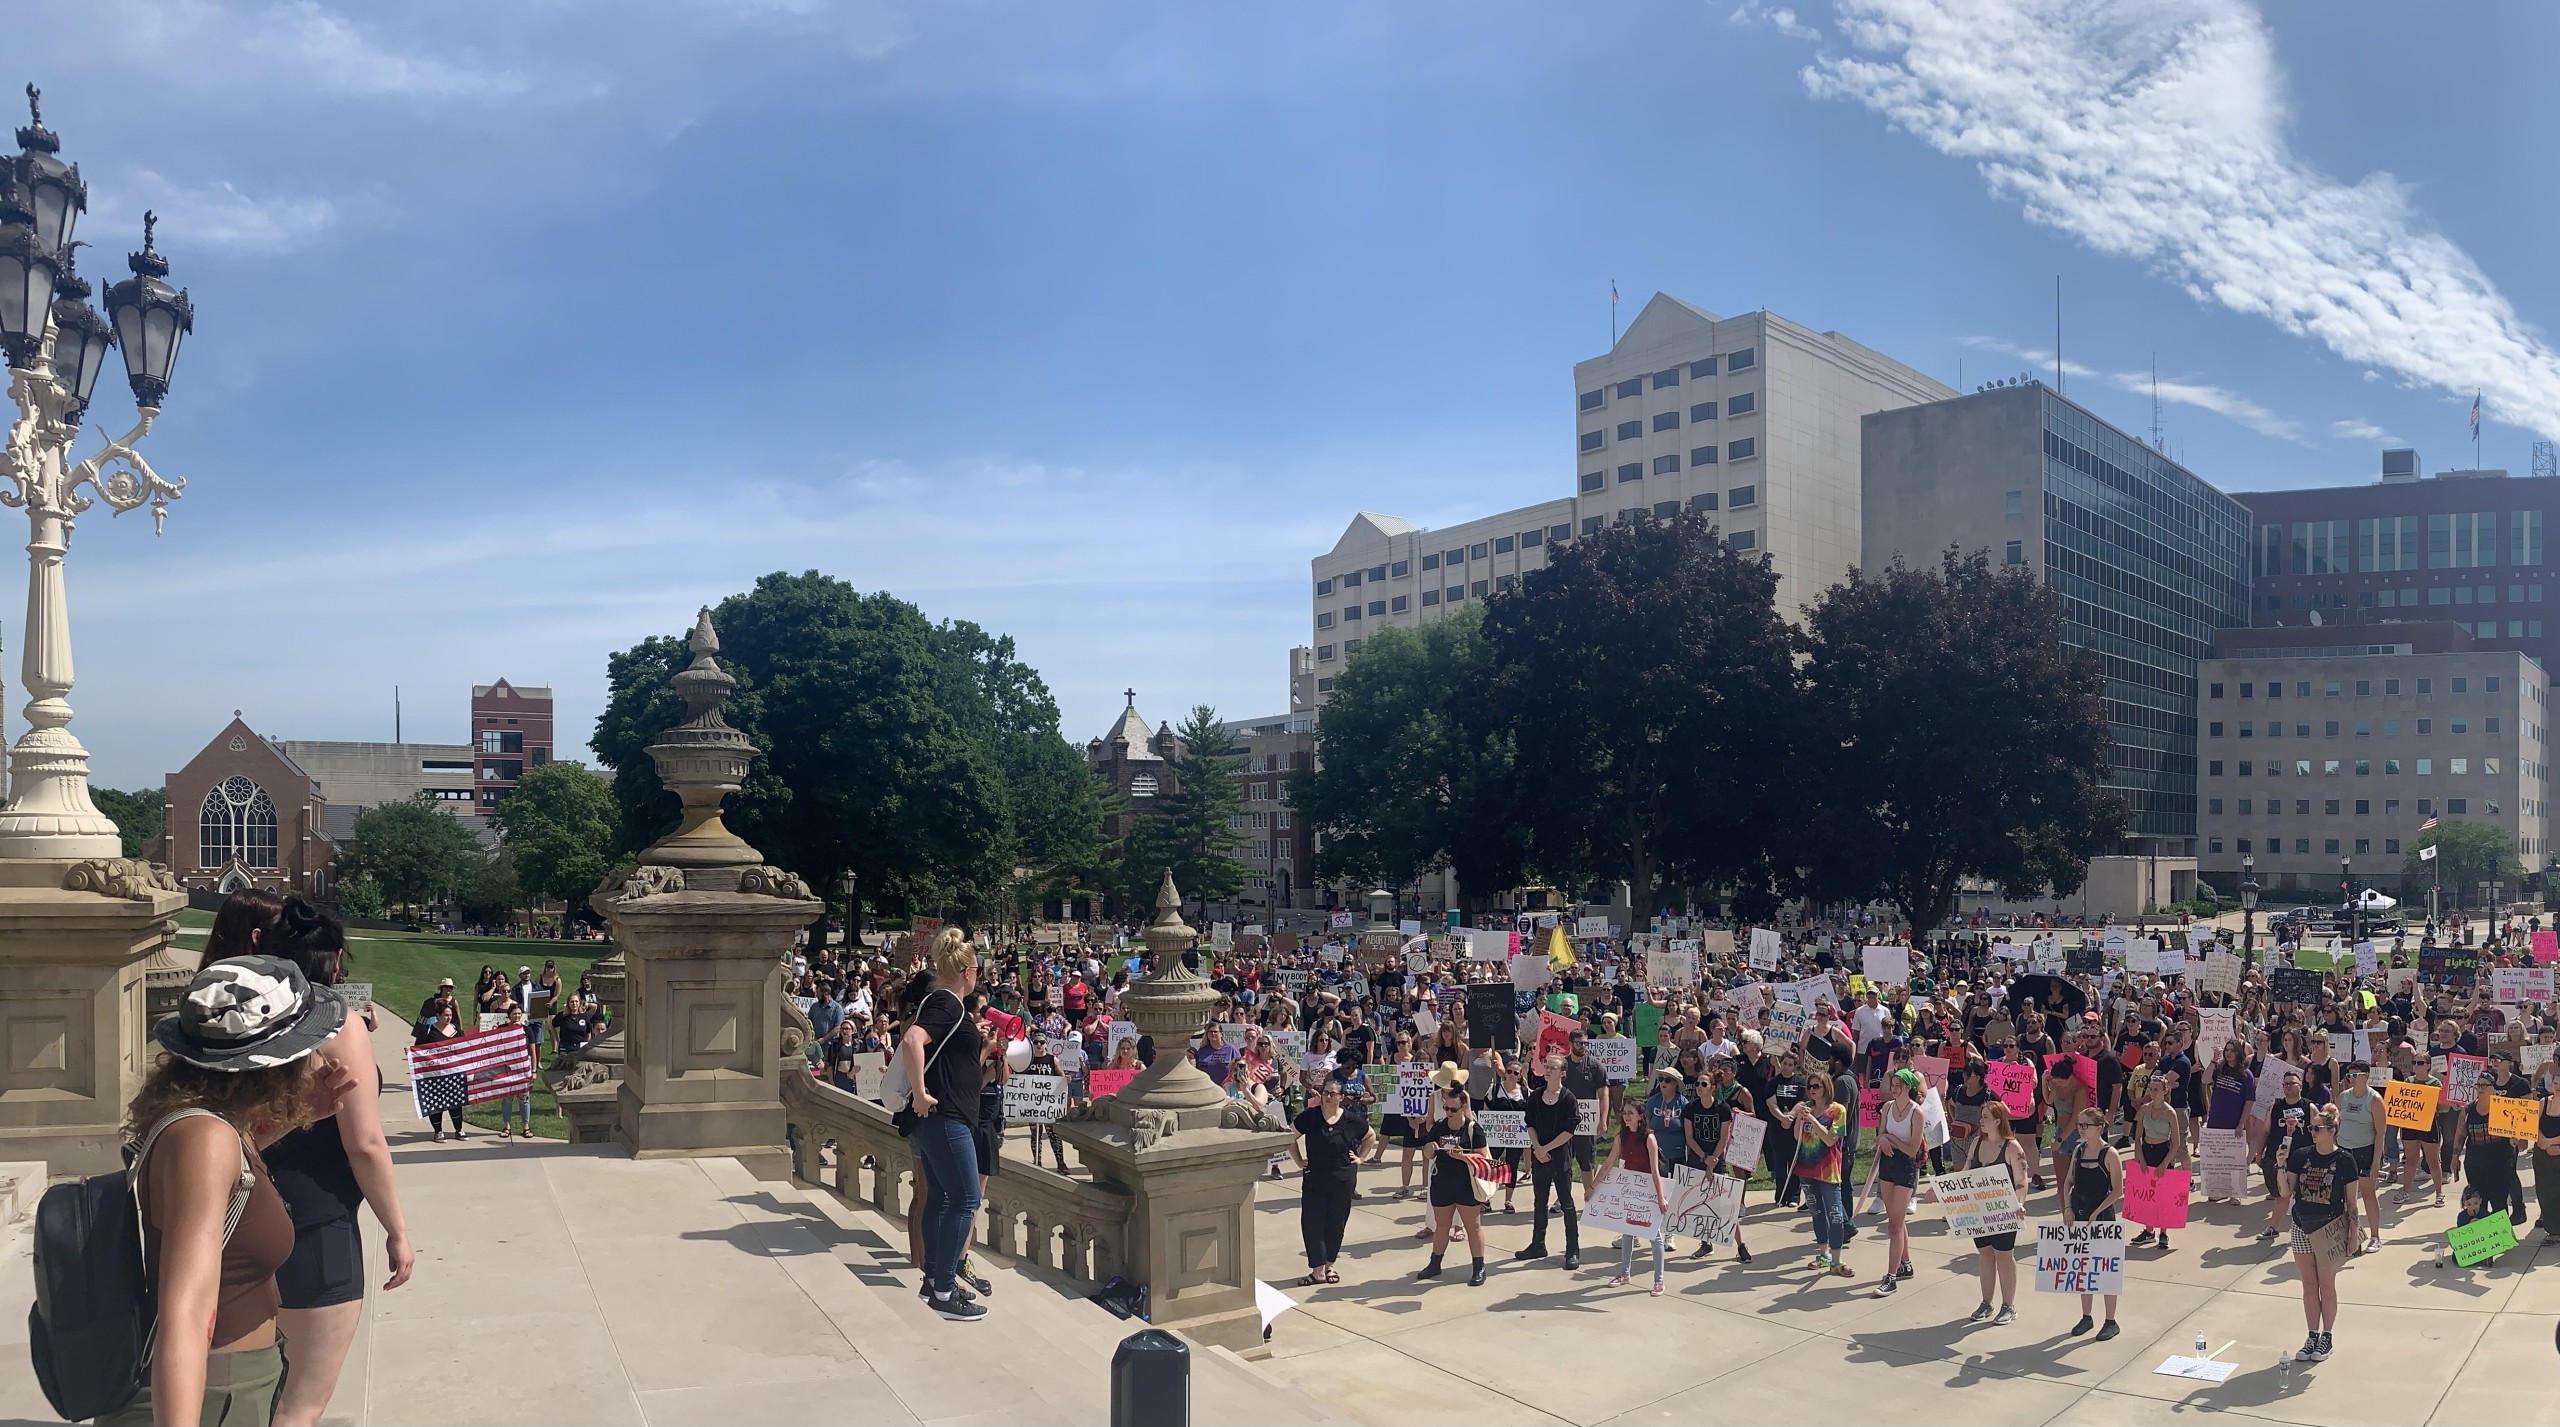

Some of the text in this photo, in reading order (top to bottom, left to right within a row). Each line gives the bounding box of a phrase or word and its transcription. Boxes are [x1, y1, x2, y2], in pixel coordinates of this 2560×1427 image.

[1365, 934, 1399, 946] ABORTION
[1276, 972, 1308, 985] MY BODY
[1770, 1010, 1804, 1027] NEVER
[1763, 1027, 1798, 1042] AGAIN
[1606, 1042, 1626, 1050] WILL
[1588, 1049, 1630, 1058] NLY STOP
[1411, 1062, 1425, 1070] ITS
[1600, 1057, 1617, 1065] AFE
[1401, 1069, 1430, 1079] PATRIOT
[1605, 1065, 1630, 1073] TIONS
[2456, 1069, 2477, 1079] FREE
[1031, 1076, 1052, 1089] have
[1412, 1078, 1424, 1086] TO
[2002, 1079, 2022, 1092] NOT
[1004, 1089, 1067, 1108] more rights if
[1401, 1086, 1434, 1098] VOTE
[2399, 1086, 2423, 1098] KEEP
[1403, 1099, 1429, 1116] BLU
[2388, 1095, 2426, 1111] ABORTION
[1004, 1104, 1068, 1120] I were a GUN
[2386, 1107, 2419, 1122] LEGAL
[1482, 1124, 1528, 1133] WOMEN
[1694, 1115, 1720, 1129] PRO
[1634, 1173, 1649, 1186] THE
[1677, 1165, 1697, 1188] WE
[1975, 1178, 1990, 1189] until
[1941, 1187, 2012, 1204] WOMEN INDIGENOUS
[2132, 1186, 2156, 1203] WAR
[1945, 1199, 2010, 1215] DISABLED BLACK
[1665, 1212, 1688, 1234] GO
[1951, 1209, 2020, 1228] LGBTQ+ IMMIGRANT
[1966, 1225, 1986, 1235] DYING
[1987, 1225, 1995, 1233] IN
[2038, 1223, 2123, 1242] THIS WAS NEVER
[2063, 1242, 2090, 1255] THE
[2038, 1256, 2121, 1273] LAND OF THE
[2054, 1271, 2099, 1293] FREE
